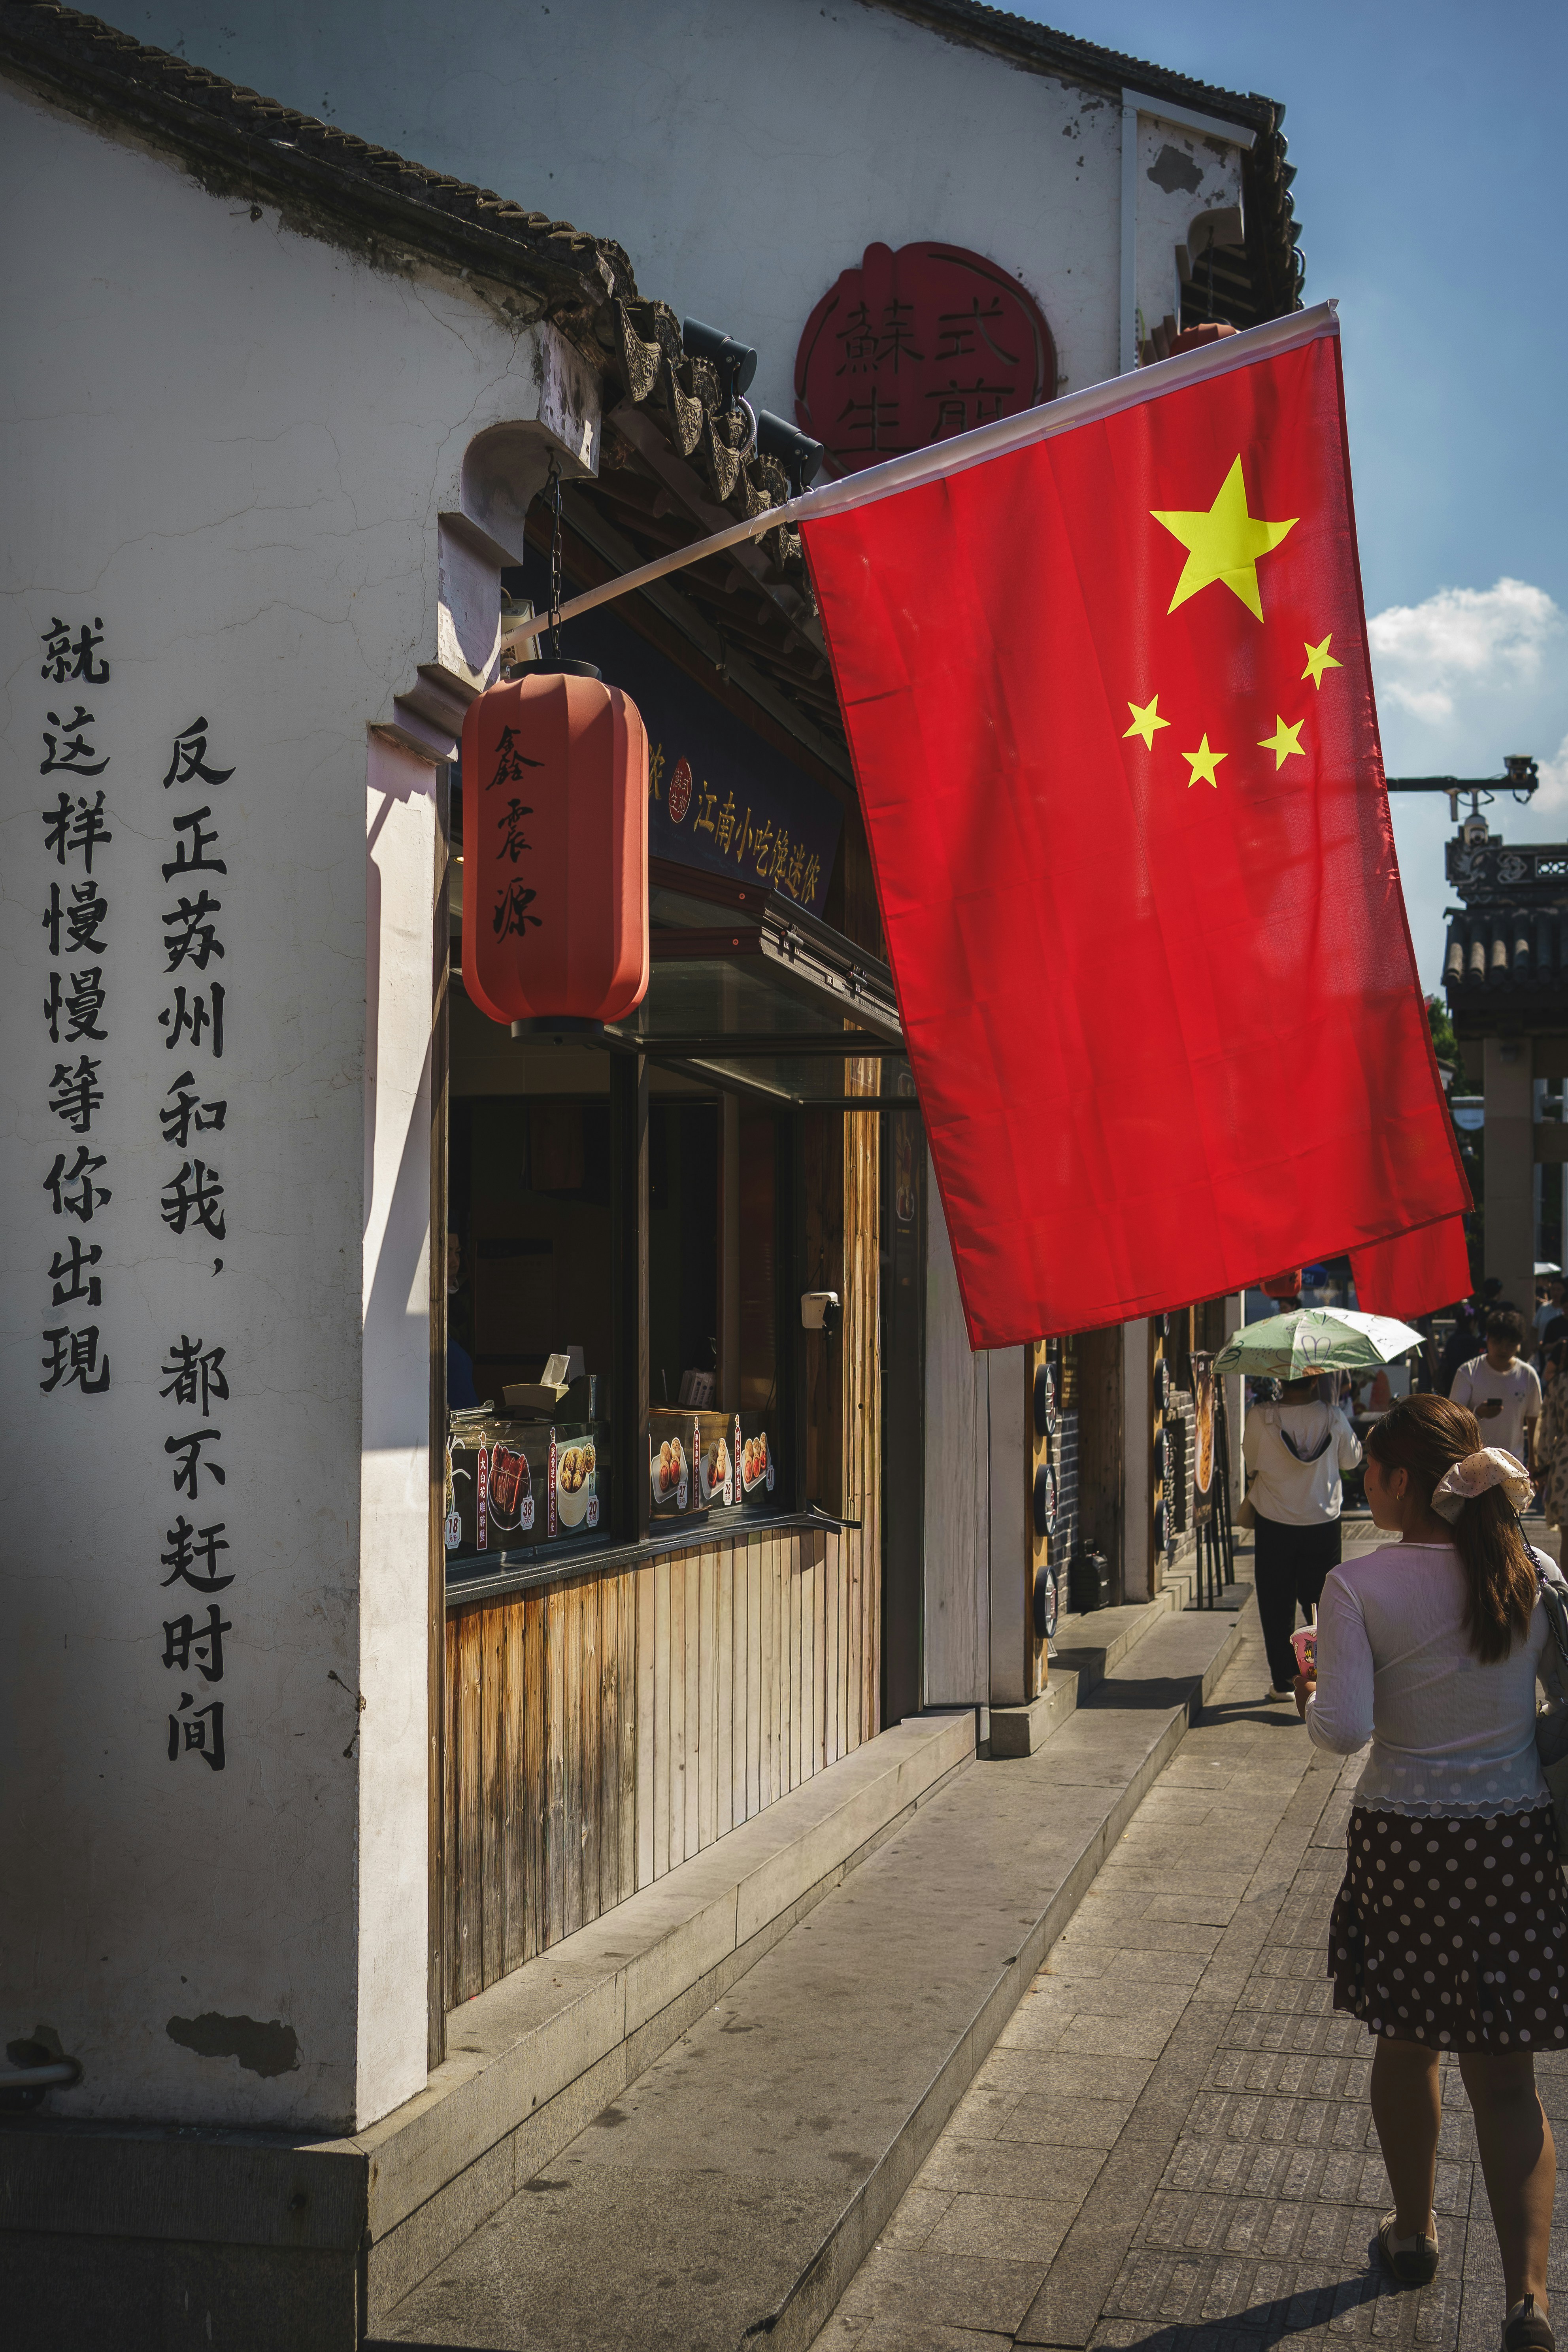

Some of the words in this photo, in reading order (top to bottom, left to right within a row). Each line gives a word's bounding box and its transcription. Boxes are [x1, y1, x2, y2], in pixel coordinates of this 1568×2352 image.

[835, 296, 1020, 376] 蘇式
[485, 725, 545, 944] 鑫震源
[679, 1485, 686, 1497] 27
[725, 1484, 731, 1495] 28
[523, 1501, 532, 1517] 38
[589, 1501, 597, 1515] 20
[449, 1518, 458, 1534] 18
